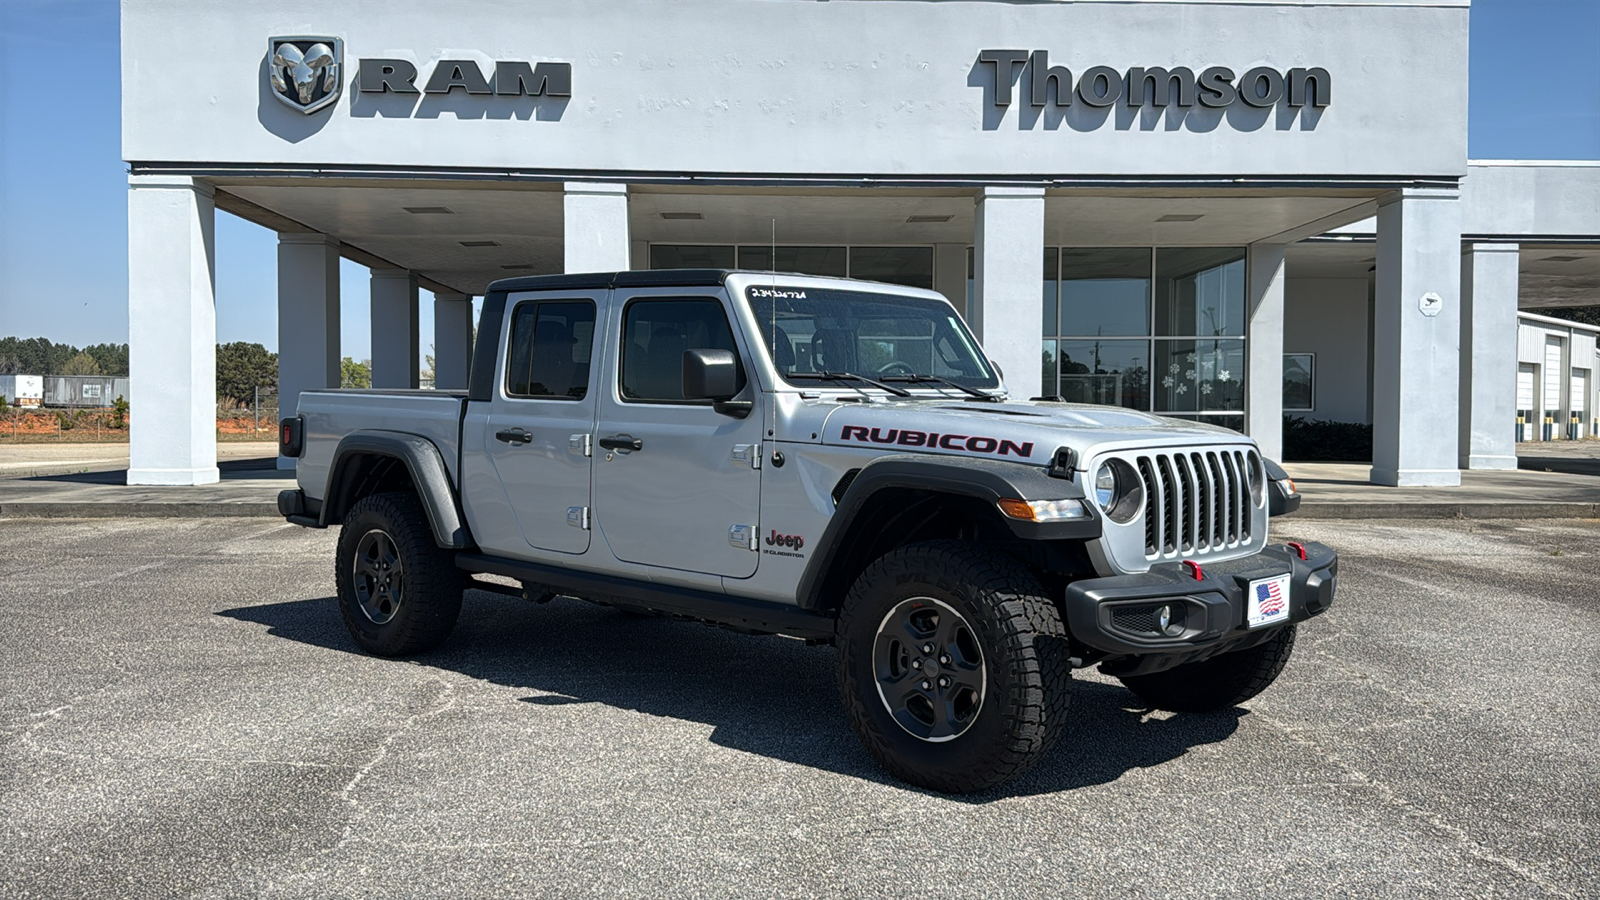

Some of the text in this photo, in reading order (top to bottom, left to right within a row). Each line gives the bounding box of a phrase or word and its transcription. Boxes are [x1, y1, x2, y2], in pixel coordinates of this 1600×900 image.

[358, 58, 572, 96] RAM
[979, 49, 1332, 107] Thomson
[840, 425, 1034, 457] RUBICON
[765, 529, 805, 551] Jeep
[769, 549, 805, 558] GLADIATOR
